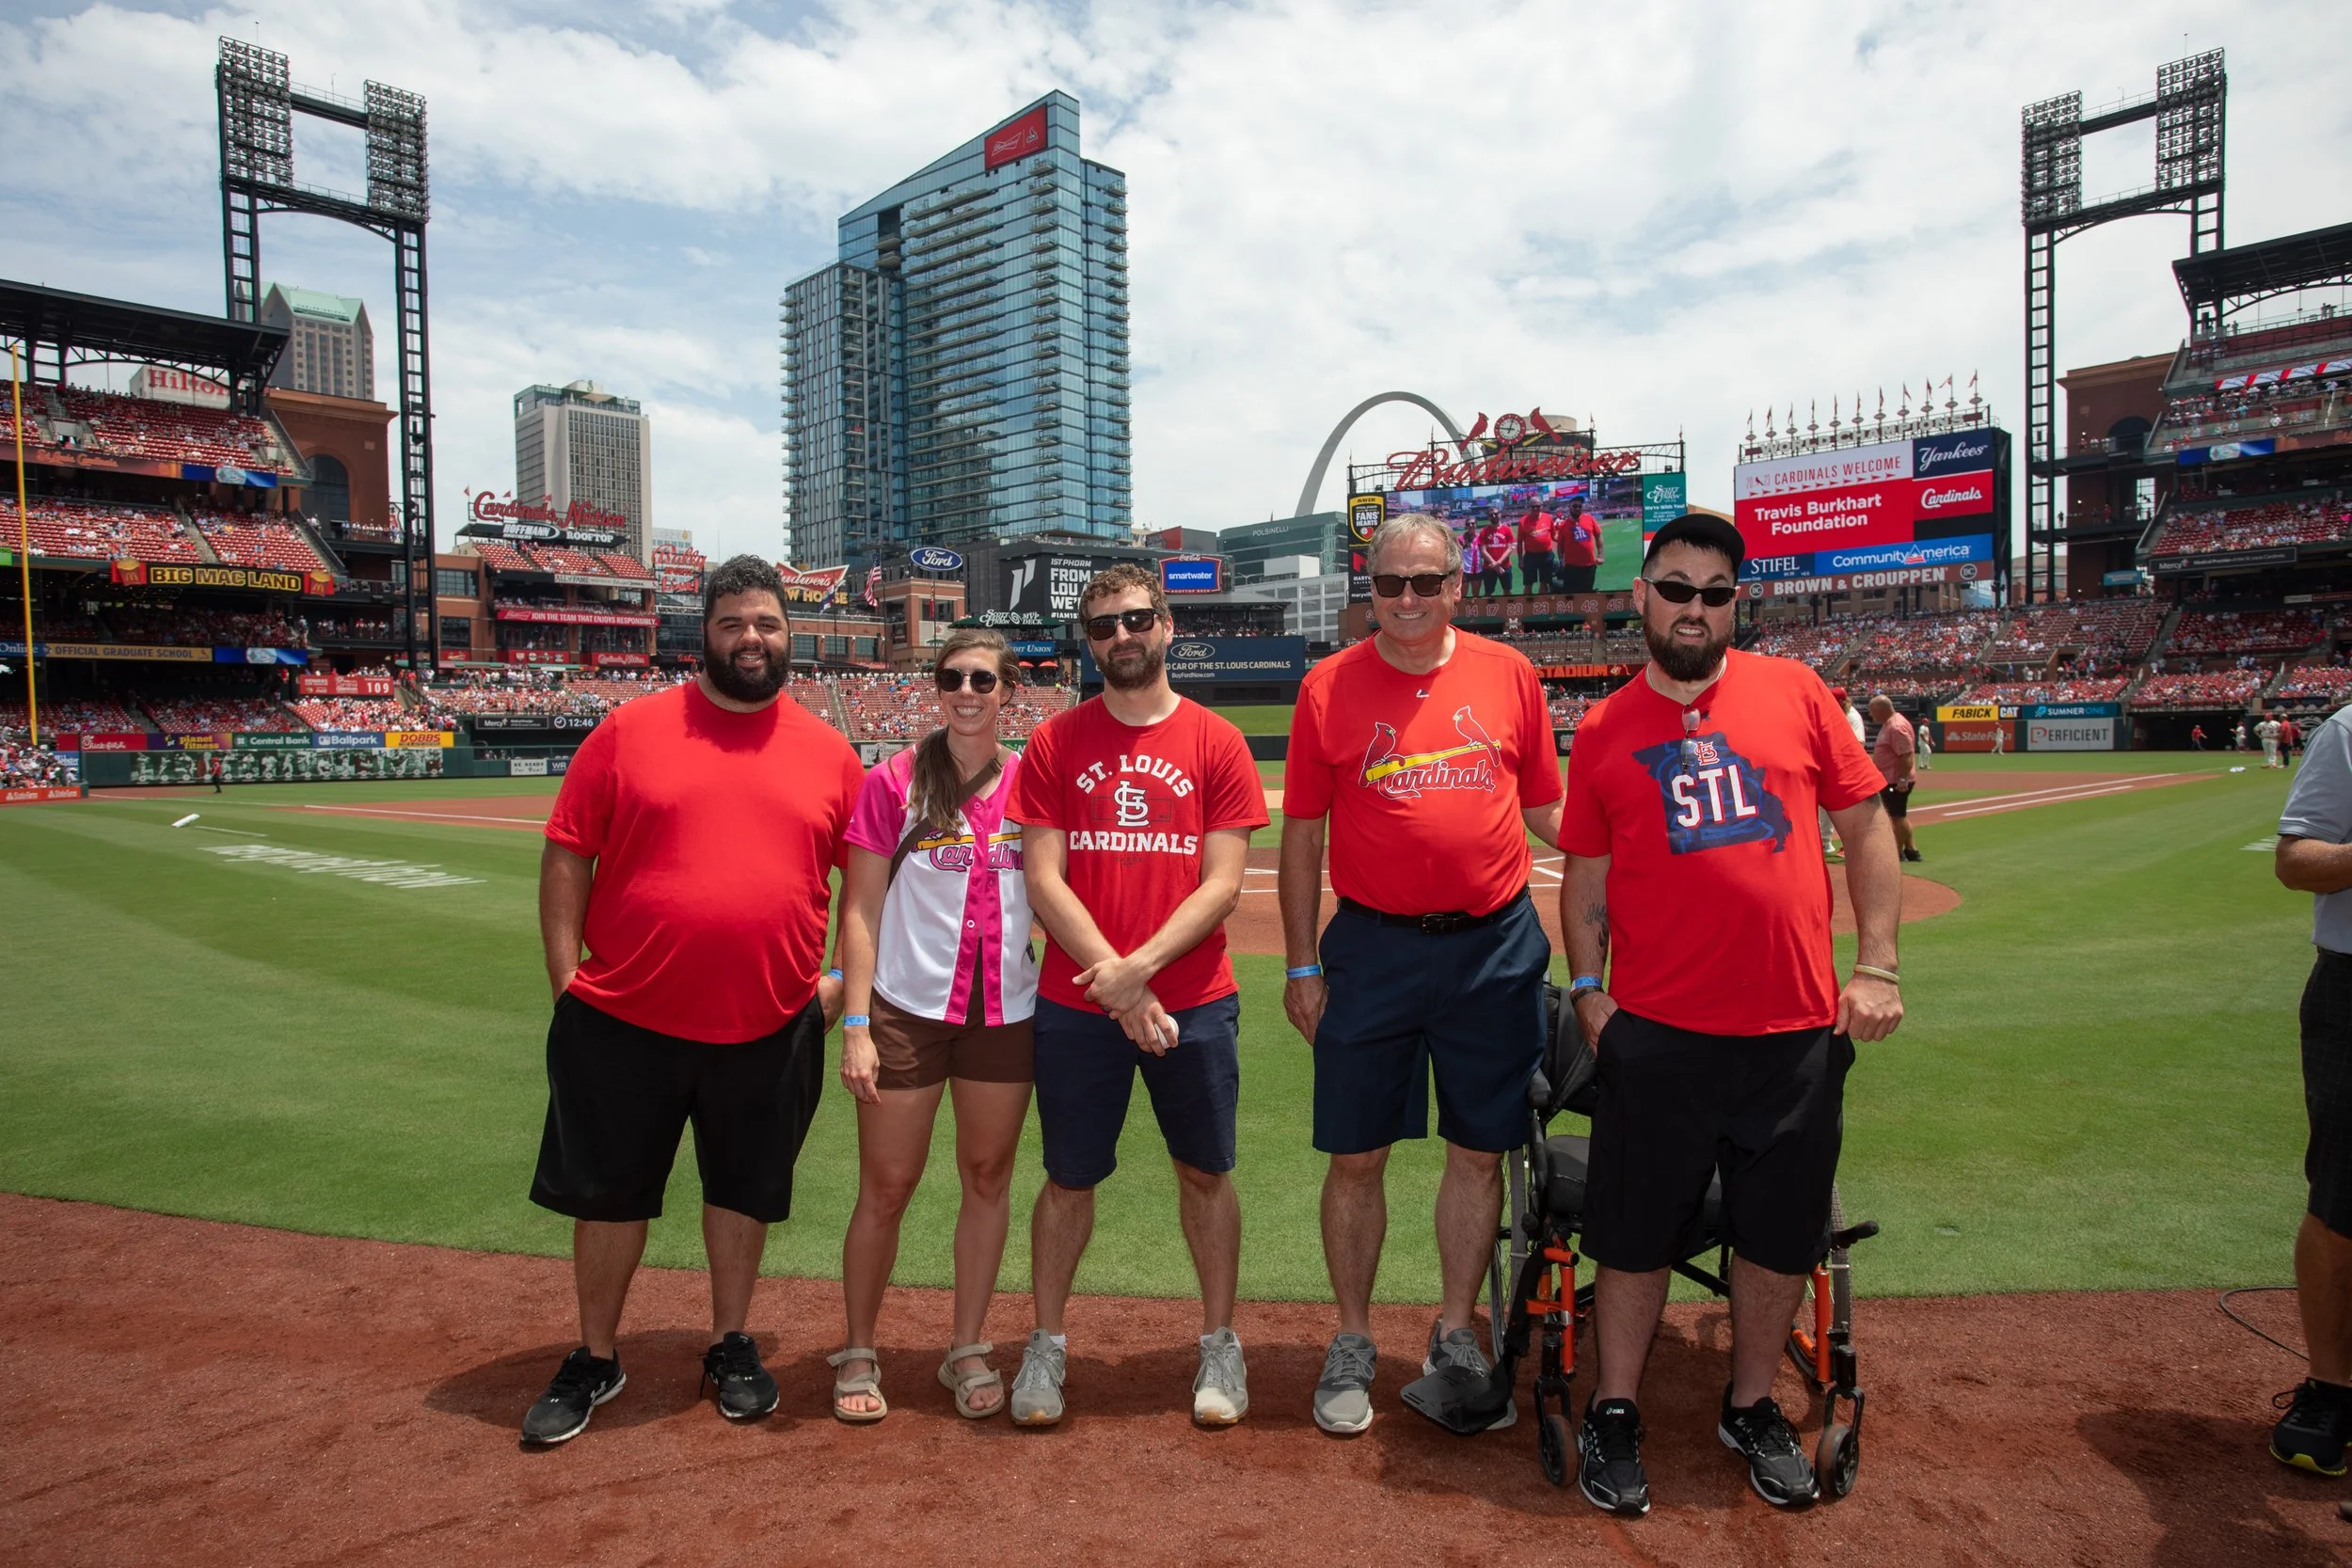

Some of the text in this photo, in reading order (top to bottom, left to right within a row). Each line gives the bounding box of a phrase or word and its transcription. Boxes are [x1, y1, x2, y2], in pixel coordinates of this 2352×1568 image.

[1760, 415, 1964, 455] WORLD CHAMPIONS
[1919, 441, 1985, 471] Yankees
[1387, 442, 1641, 491] Budweiser
[1774, 466, 1837, 485] CARDINALS
[1843, 456, 1901, 475] WELCOME
[1921, 486, 1982, 510] Cardinals
[474, 491, 626, 528] Cardinals Nation
[1755, 494, 1882, 521] Travis Burkhart
[503, 524, 550, 537] HOFFMANN
[1252, 525, 1289, 536] POLSINELLI
[1771, 514, 1867, 535] Foundation
[566, 531, 613, 543] ROOFTOP
[922, 550, 953, 566] Ford
[1063, 559, 1091, 567] PHORM
[1751, 556, 1800, 575] STIFEL
[150, 566, 302, 592] BIG MAC LAND
[1050, 567, 1091, 582] FROM
[1773, 566, 1945, 595] BROWN & CROUPPEN
[1050, 582, 1078, 595] LOU
[803, 590, 848, 604] HOSE
[1465, 605, 1479, 617] 14
[1486, 604, 1500, 616] 17
[1507, 603, 1523, 615] 20
[1533, 601, 1549, 614] 23
[1556, 600, 1573, 613] 24
[1581, 599, 1598, 612] 42
[1607, 598, 1624, 611] 45
[560, 613, 577, 622] TEAM
[594, 614, 615, 624] ENJOYS
[616, 615, 658, 626] RESPONSIBLY.
[0, 642, 194, 659] Onlie OFFICIAL GRADUATE SCHOOL
[1178, 644, 1207, 657] Ford
[1249, 660, 1291, 669] CARDINALS
[1952, 706, 2019, 719] FABICK CAT
[485, 720, 503, 728] Mercy
[569, 719, 594, 727] 12:46
[179, 734, 214, 747] planet
[249, 736, 310, 745] Central Bank
[331, 735, 378, 745] Ballpark
[400, 734, 441, 742] DOBBS
[2031, 727, 2108, 743] PERFICIENT
[1076, 754, 1194, 798] ST. LOUIS
[1377, 759, 1497, 800] Cardinals
[1671, 764, 1759, 828] STL
[1070, 831, 1199, 855] CARDINALS
